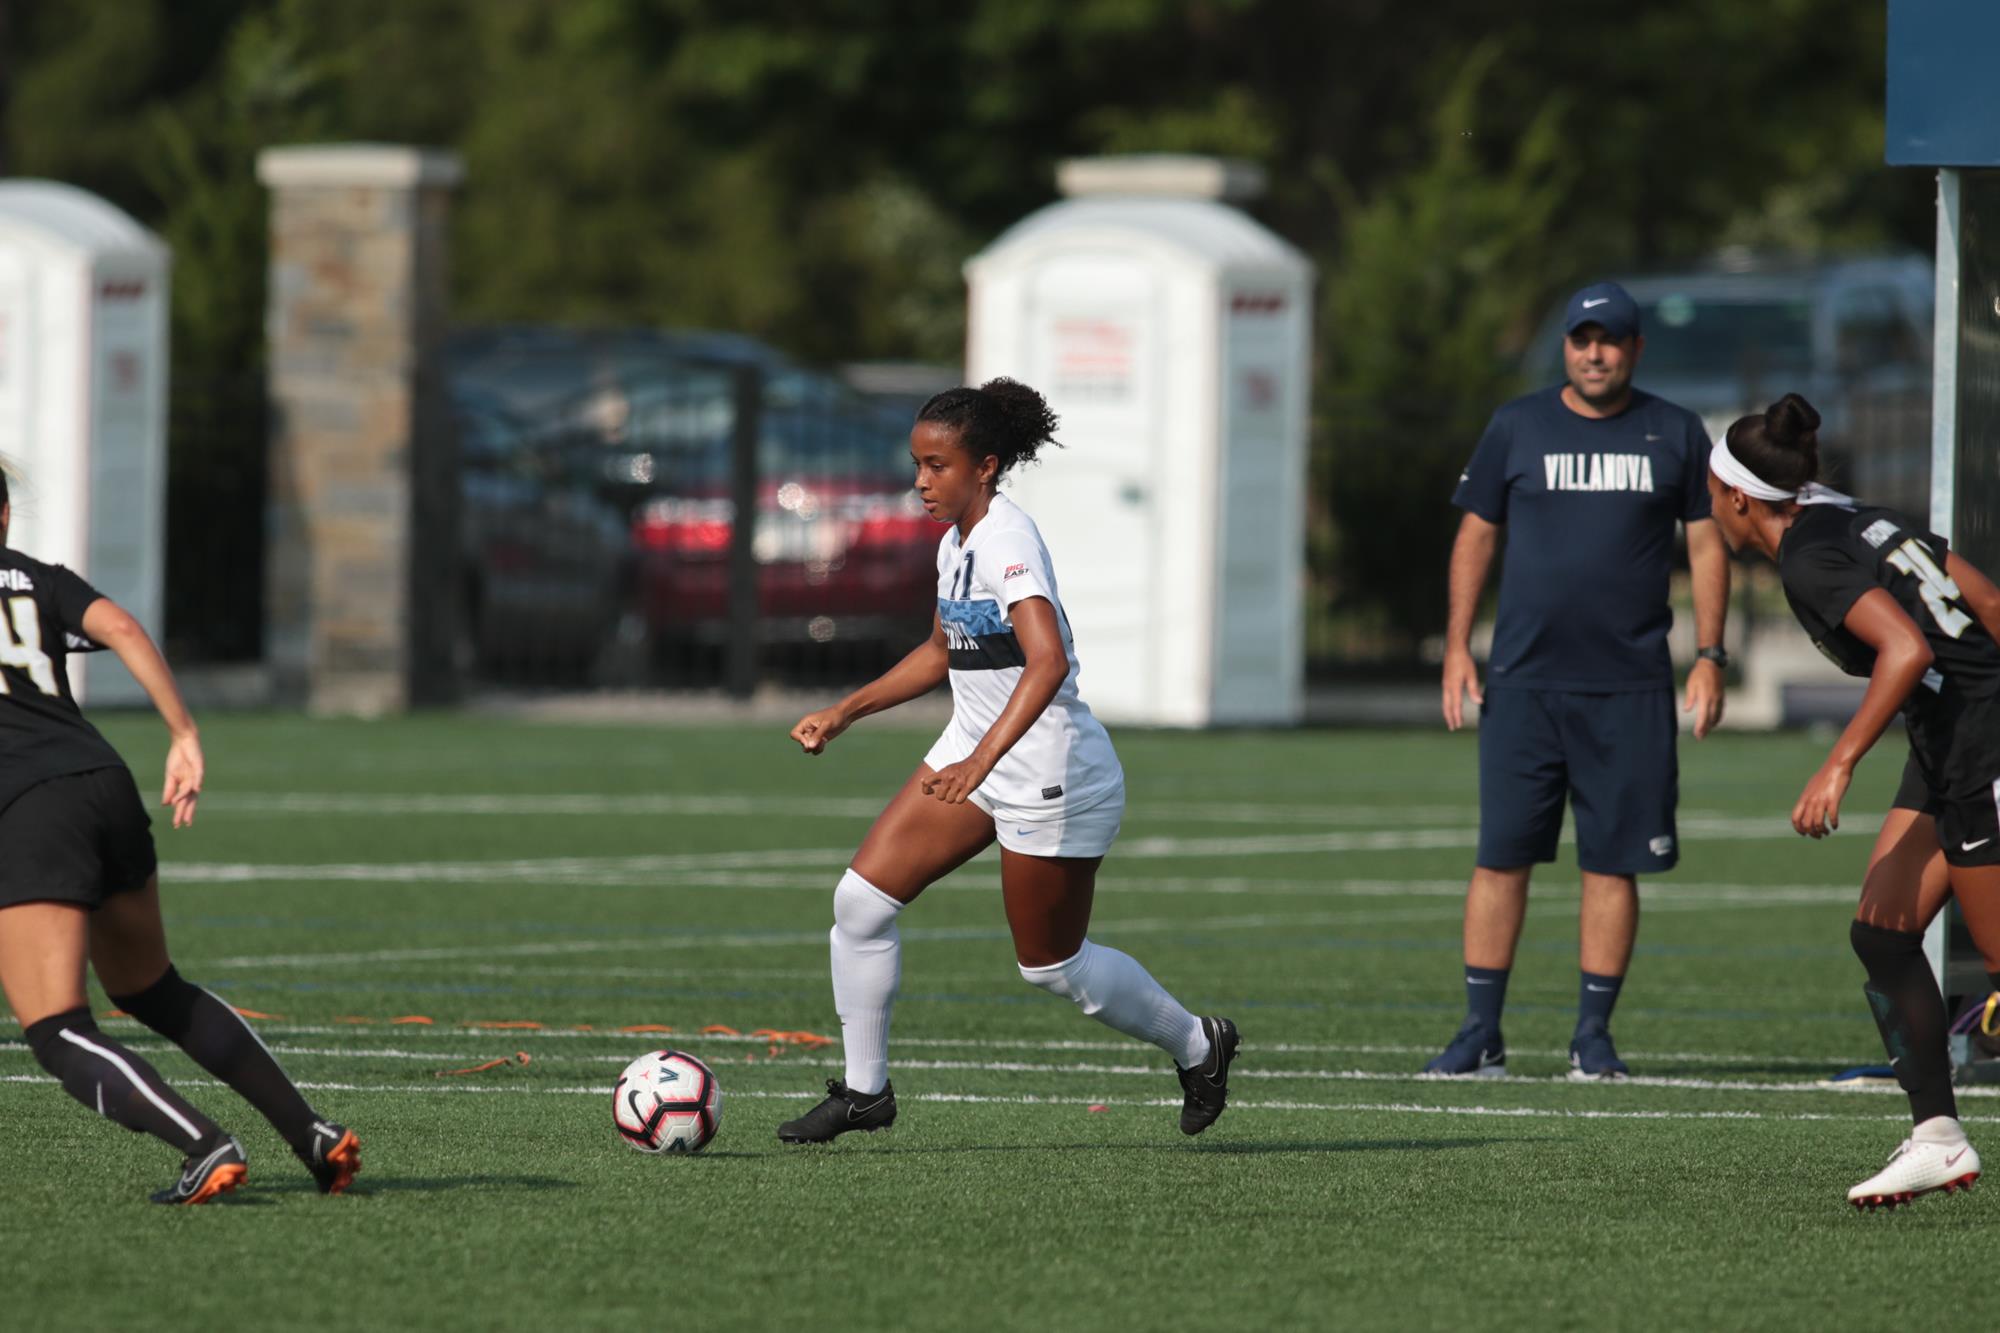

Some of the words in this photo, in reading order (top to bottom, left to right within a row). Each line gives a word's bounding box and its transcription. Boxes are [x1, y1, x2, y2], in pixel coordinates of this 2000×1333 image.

[1543, 453, 1654, 493] VILLANOVA
[1004, 568, 1029, 579] EAST
[0, 595, 60, 697] 4
